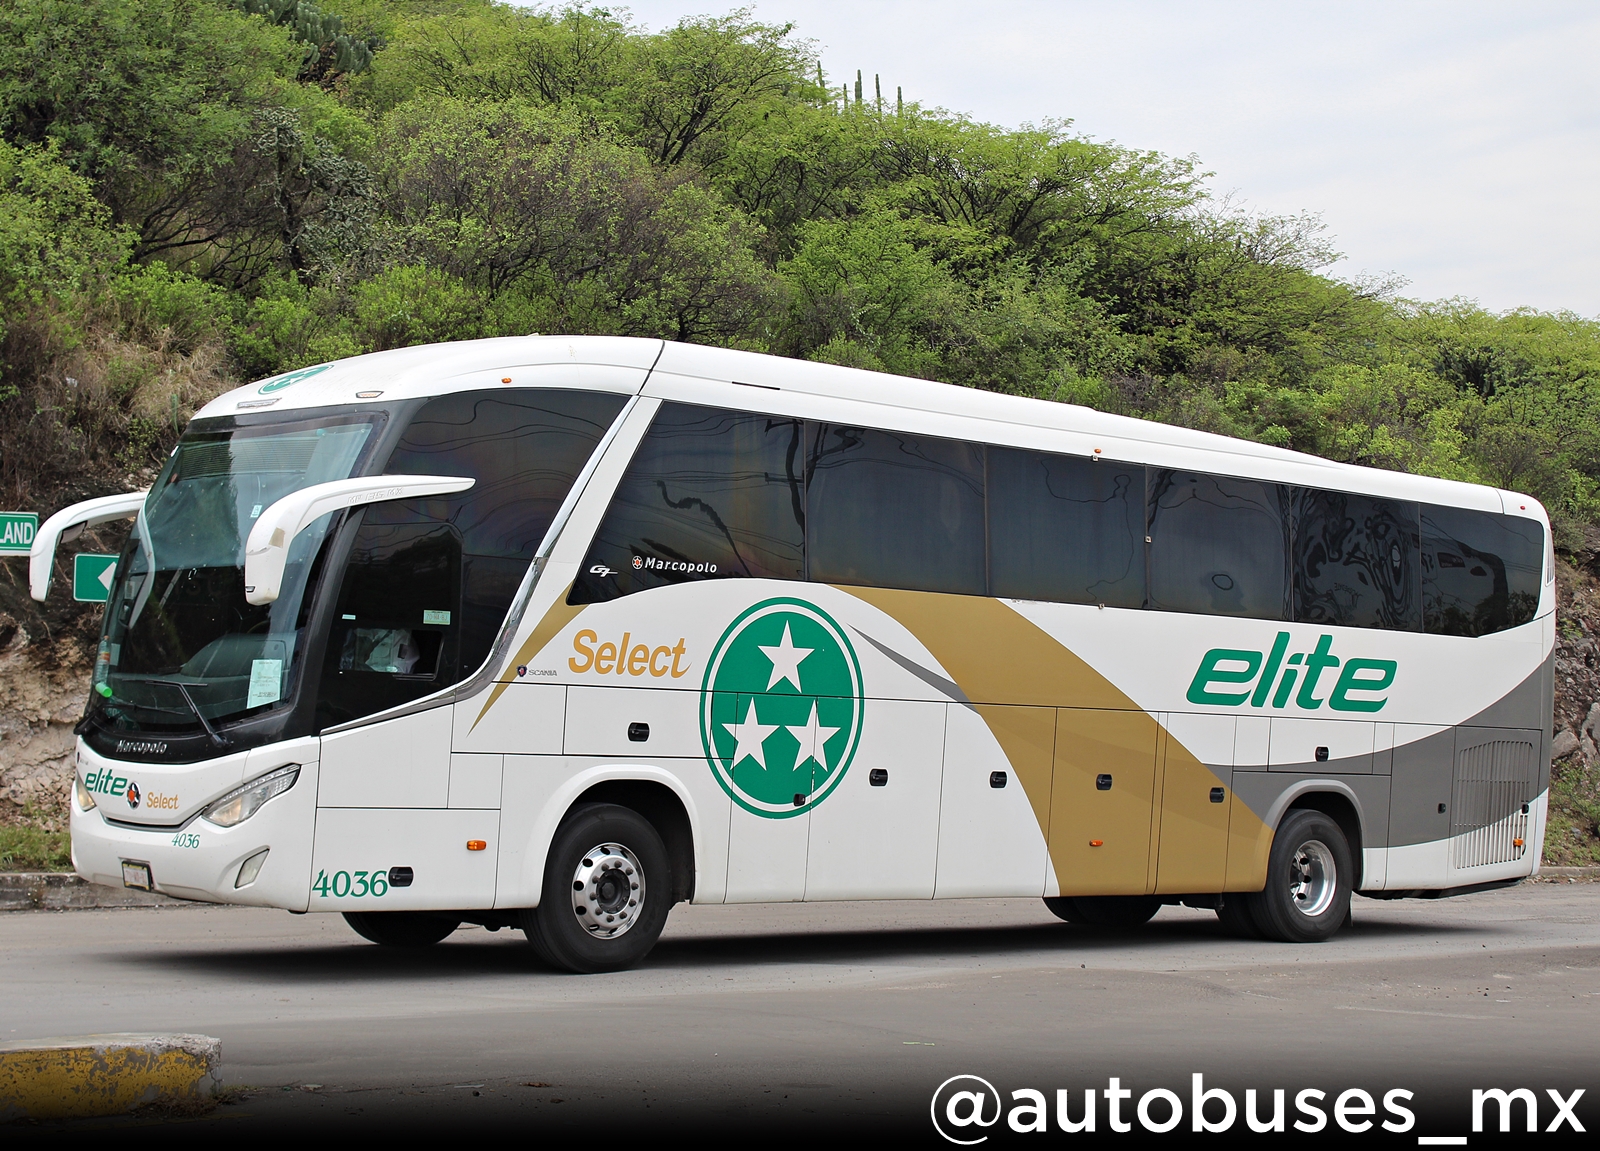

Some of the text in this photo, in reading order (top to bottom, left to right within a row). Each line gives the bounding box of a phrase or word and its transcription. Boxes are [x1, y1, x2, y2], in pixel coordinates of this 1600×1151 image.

[644, 557, 717, 573] Marcopolo
[568, 629, 692, 678] Select
[1186, 631, 1397, 712] elite
[116, 740, 167, 754] Marcopolo
[85, 768, 127, 796] elite
[146, 791, 180, 810] Select
[171, 832, 200, 849] 4036
[312, 868, 388, 898] 4036
